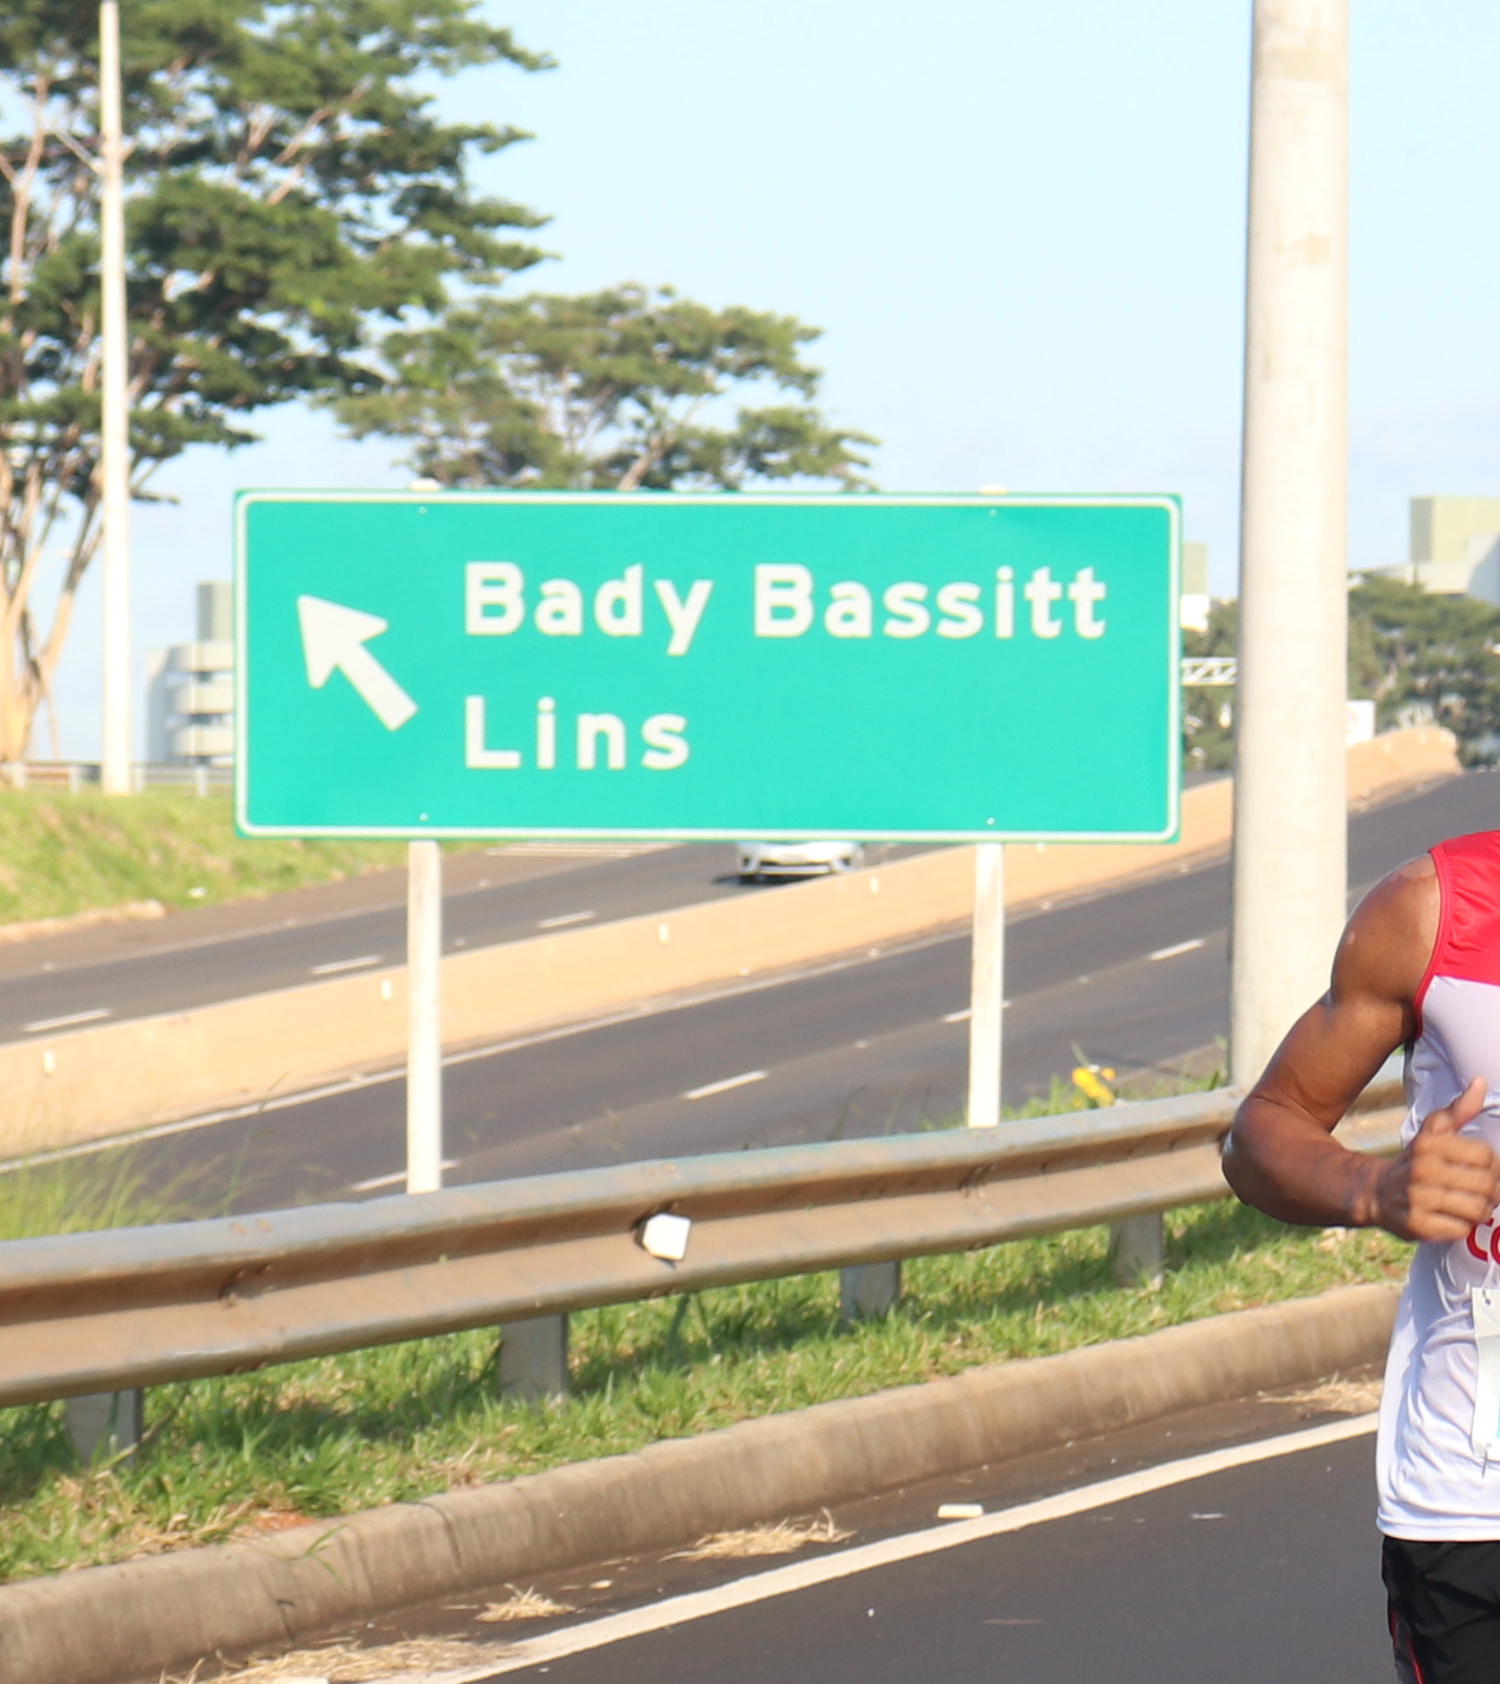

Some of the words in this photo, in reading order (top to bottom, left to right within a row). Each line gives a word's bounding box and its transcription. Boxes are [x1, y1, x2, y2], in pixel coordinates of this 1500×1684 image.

[464, 561, 714, 657] Bady
[753, 563, 1107, 640] Bassitt
[464, 694, 690, 771] Lins
